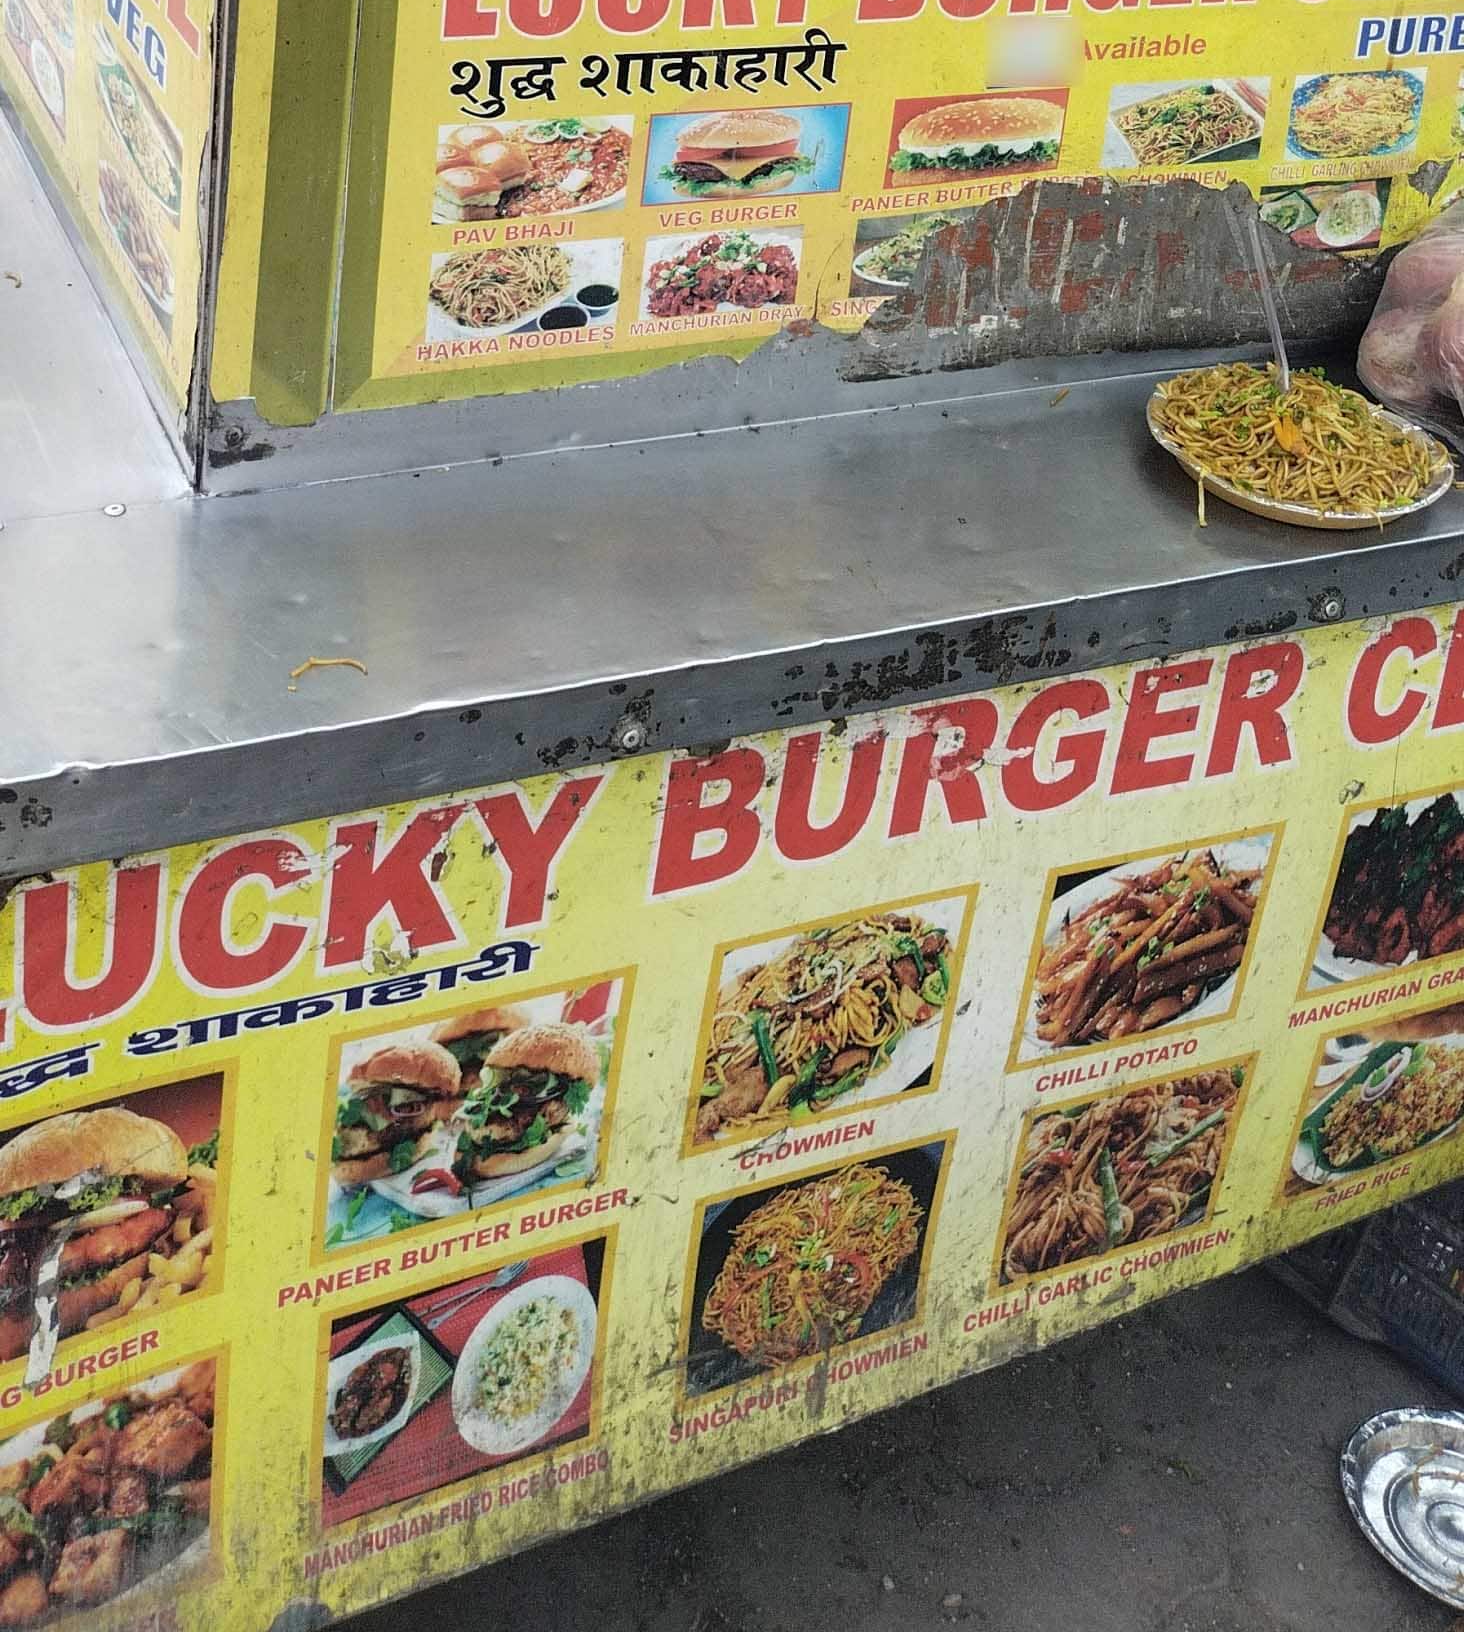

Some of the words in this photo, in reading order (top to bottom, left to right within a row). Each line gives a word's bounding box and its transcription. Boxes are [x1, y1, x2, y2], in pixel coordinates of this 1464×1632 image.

[1356, 15, 1464, 59] PURE
[450, 56, 568, 119] शुद्ध
[579, 27, 848, 96] शाकाहारी
[659, 210, 702, 228] VEG
[711, 203, 798, 224] BURGER
[851, 191, 929, 213] PANEER
[936, 181, 1012, 204] BUTTER
[452, 227, 496, 247] PAV
[505, 220, 574, 242] BHAJI
[416, 338, 500, 362] HAKKA
[508, 325, 616, 352] NOODLES
[630, 311, 753, 337] MANCHURIAN
[0, 775, 606, 1044] UCKY
[650, 641, 1306, 896] BURGER
[127, 939, 541, 1056] शाकाहारी
[1288, 979, 1423, 1029] MANCHURIAN
[1035, 1060, 1110, 1093] CHILLI
[1113, 1039, 1199, 1073] POTATO
[739, 1119, 876, 1171] CHOWMIEN
[1313, 1181, 1367, 1212] FRIED
[1371, 1162, 1413, 1189] RICE
[277, 1257, 392, 1308] PANEER
[399, 1221, 512, 1272] BUTTER
[518, 1188, 629, 1235] BURGER
[962, 1291, 1032, 1333] CHILLI
[1037, 1266, 1113, 1306] GARLIC
[1119, 1229, 1231, 1278] CHOWMIEN
[33, 1329, 160, 1397] BURGER
[669, 1378, 800, 1445] SINGAPURI
[806, 1332, 929, 1393] CHOWMIEN
[303, 1510, 434, 1579] MANCHURIAN
[437, 1491, 494, 1529] FRIED
[499, 1475, 541, 1508] RICE
[543, 1450, 609, 1490] COMBO
